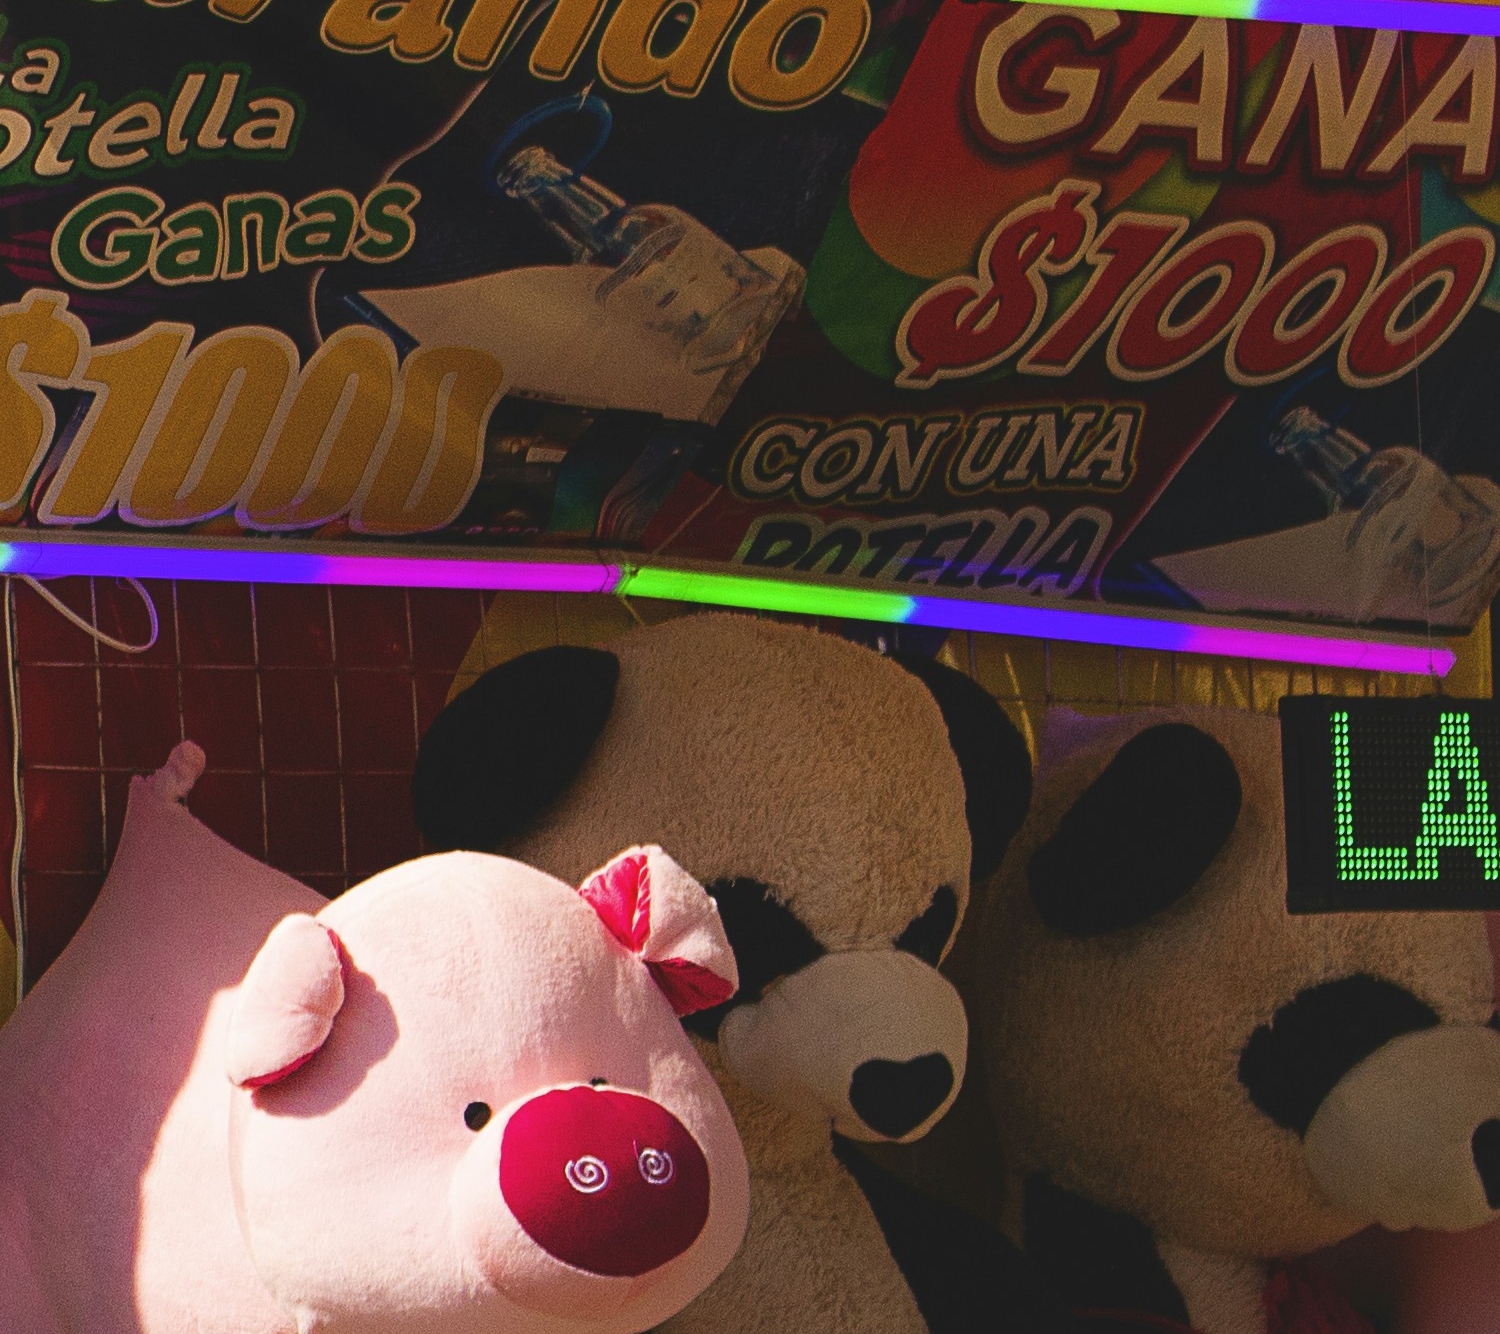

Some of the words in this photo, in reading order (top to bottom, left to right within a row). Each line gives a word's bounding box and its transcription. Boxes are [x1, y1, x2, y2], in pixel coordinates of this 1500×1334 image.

[50, 180, 423, 293] Ganas
[893, 179, 1496, 389] $1000
[732, 413, 962, 503] CON
[956, 403, 1144, 495] UNA
